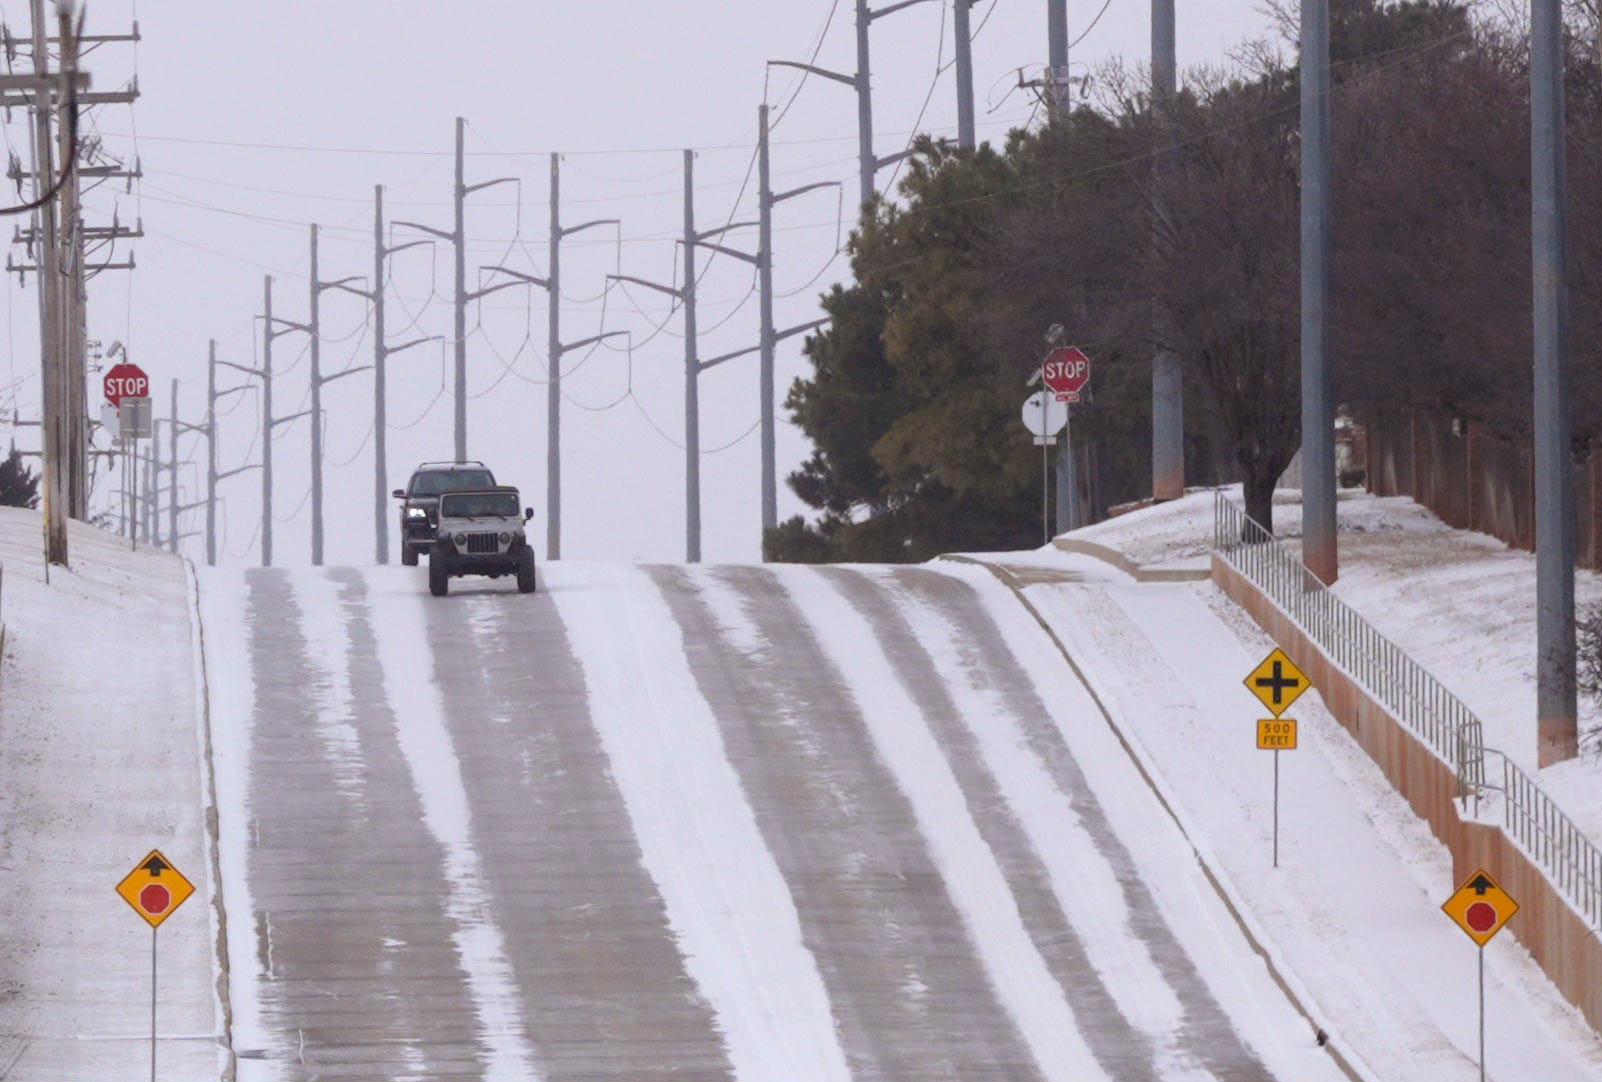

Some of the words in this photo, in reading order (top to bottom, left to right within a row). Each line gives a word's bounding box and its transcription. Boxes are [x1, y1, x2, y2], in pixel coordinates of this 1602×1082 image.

[1046, 361, 1086, 379] STOP
[106, 377, 147, 396] STOP
[1264, 723, 1290, 734] 500
[1263, 735, 1289, 746] FEET
